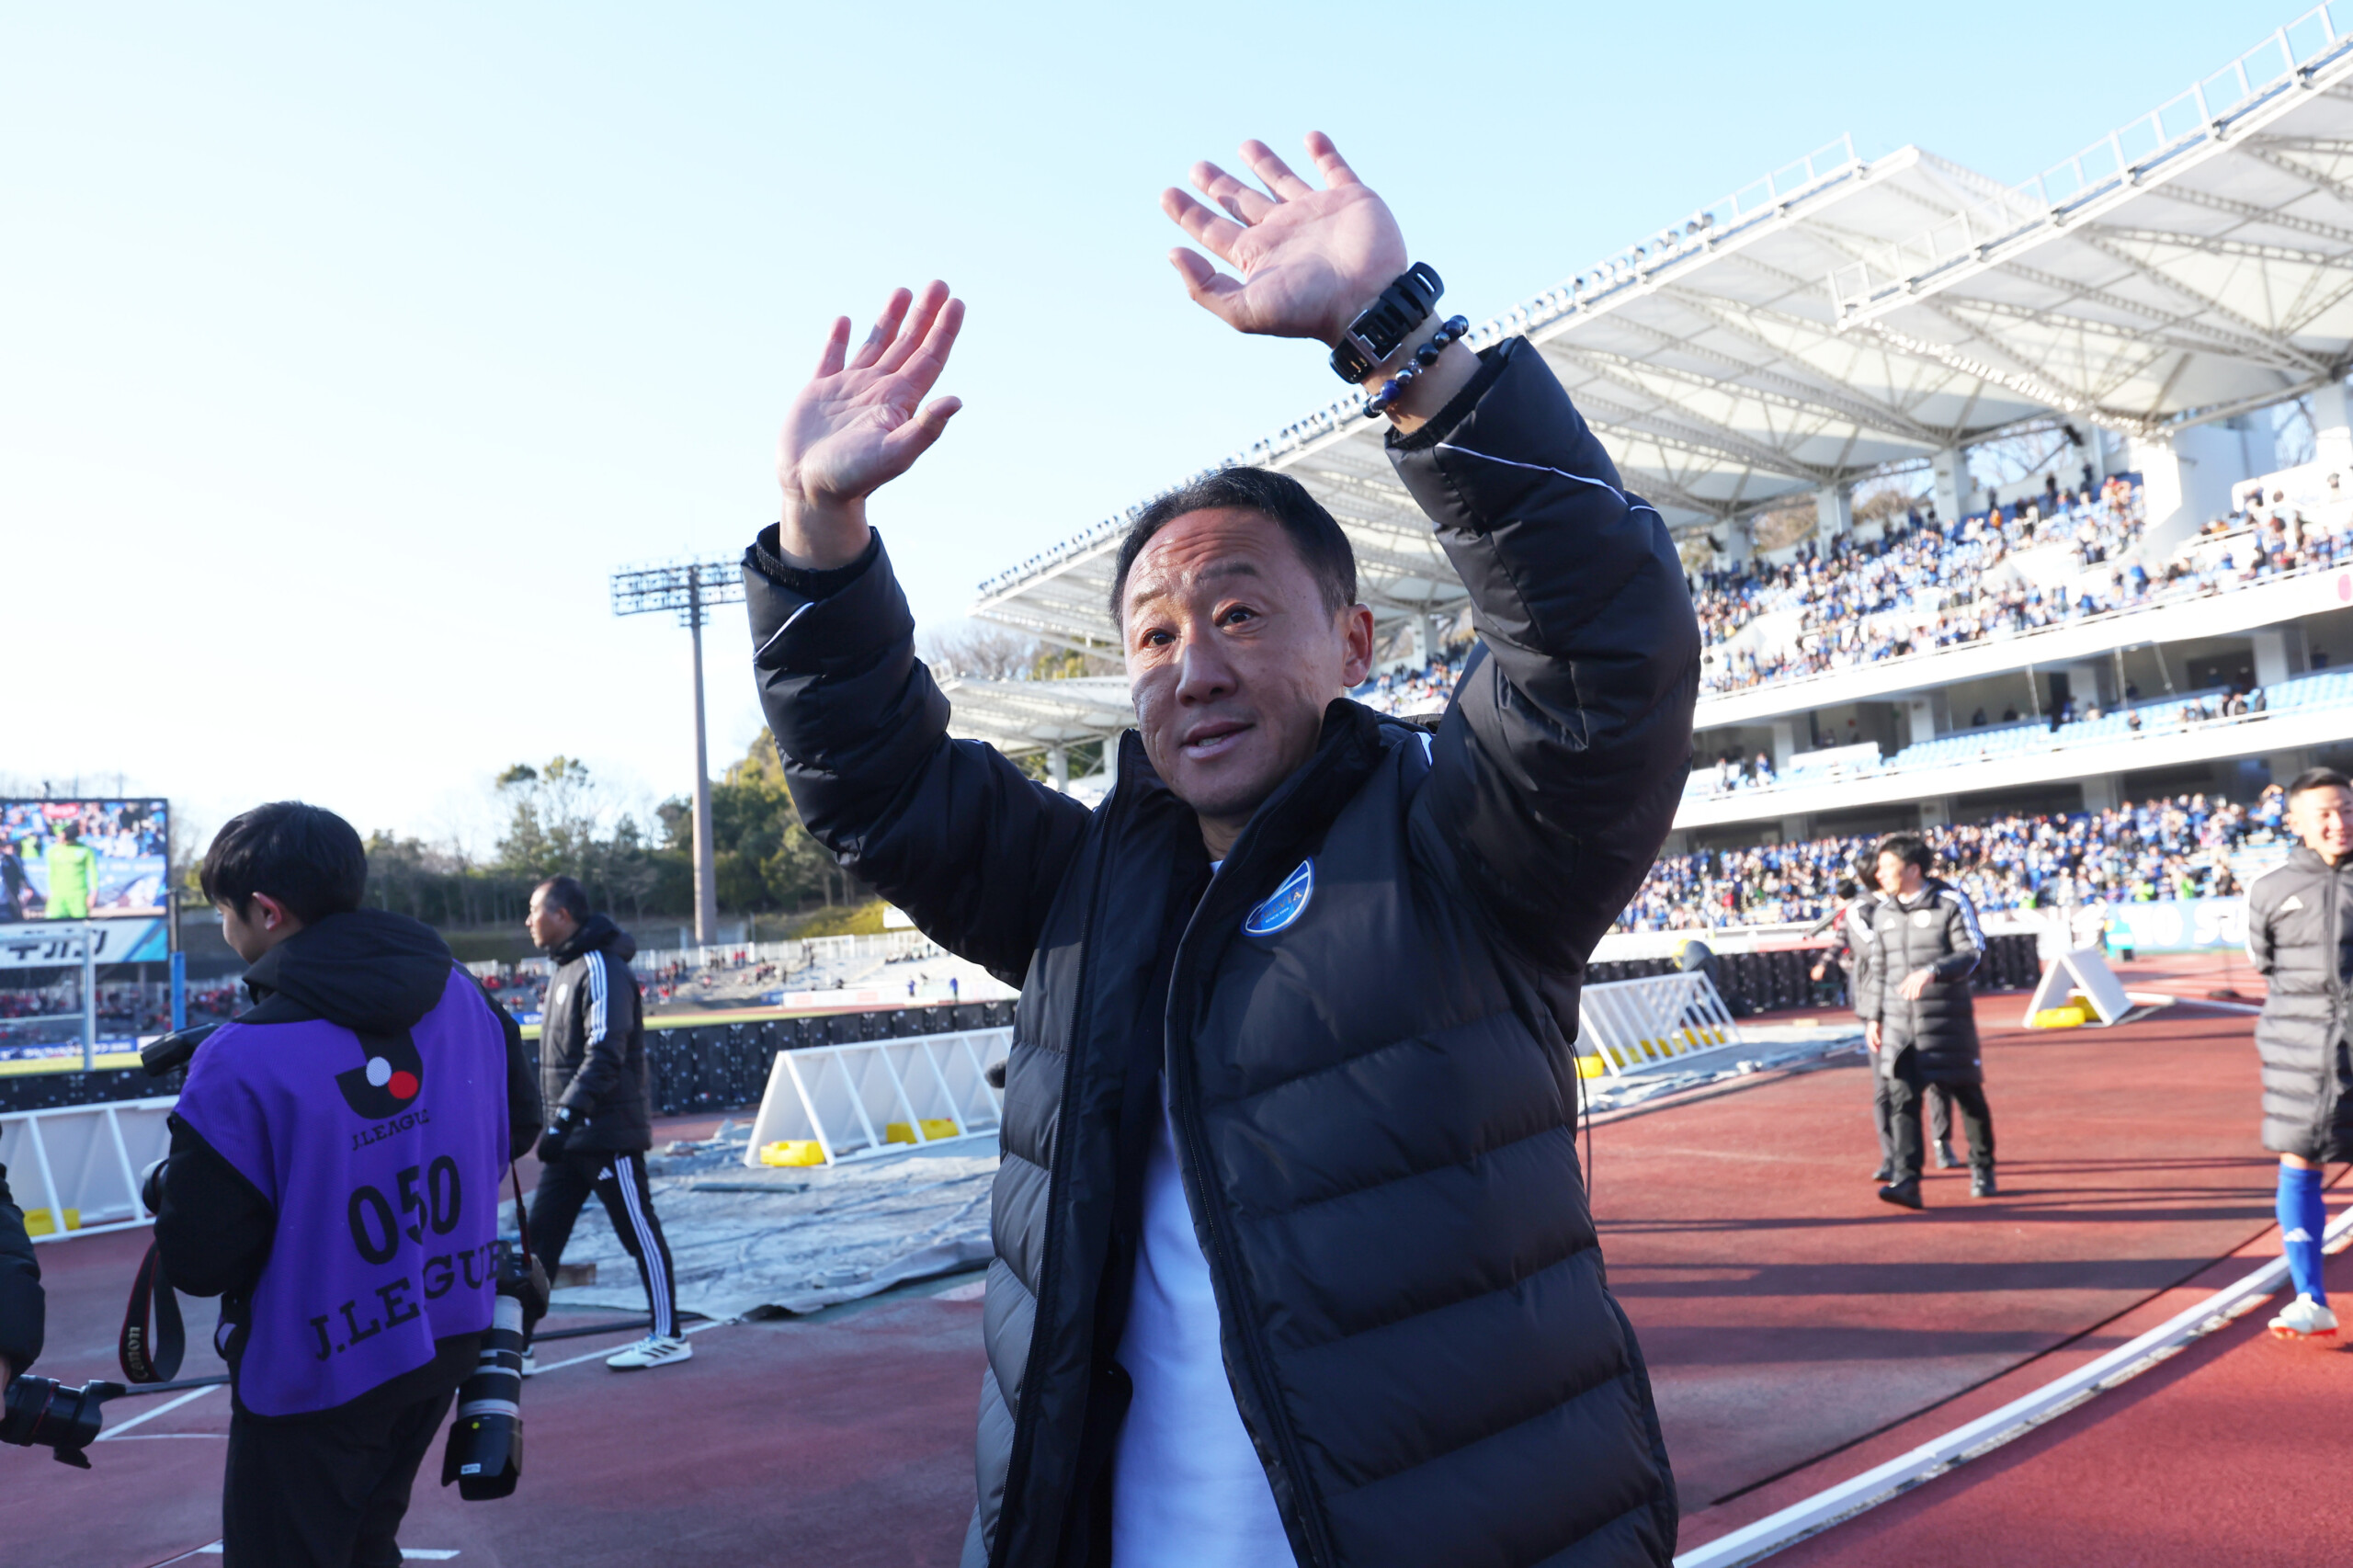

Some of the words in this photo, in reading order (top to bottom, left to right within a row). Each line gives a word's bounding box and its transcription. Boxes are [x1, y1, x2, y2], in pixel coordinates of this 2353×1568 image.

[352, 1108, 430, 1151] J.LEAGU
[347, 1154, 461, 1266] 050
[309, 1240, 498, 1362] J.LEGUE
[128, 1326, 149, 1380] Canon
